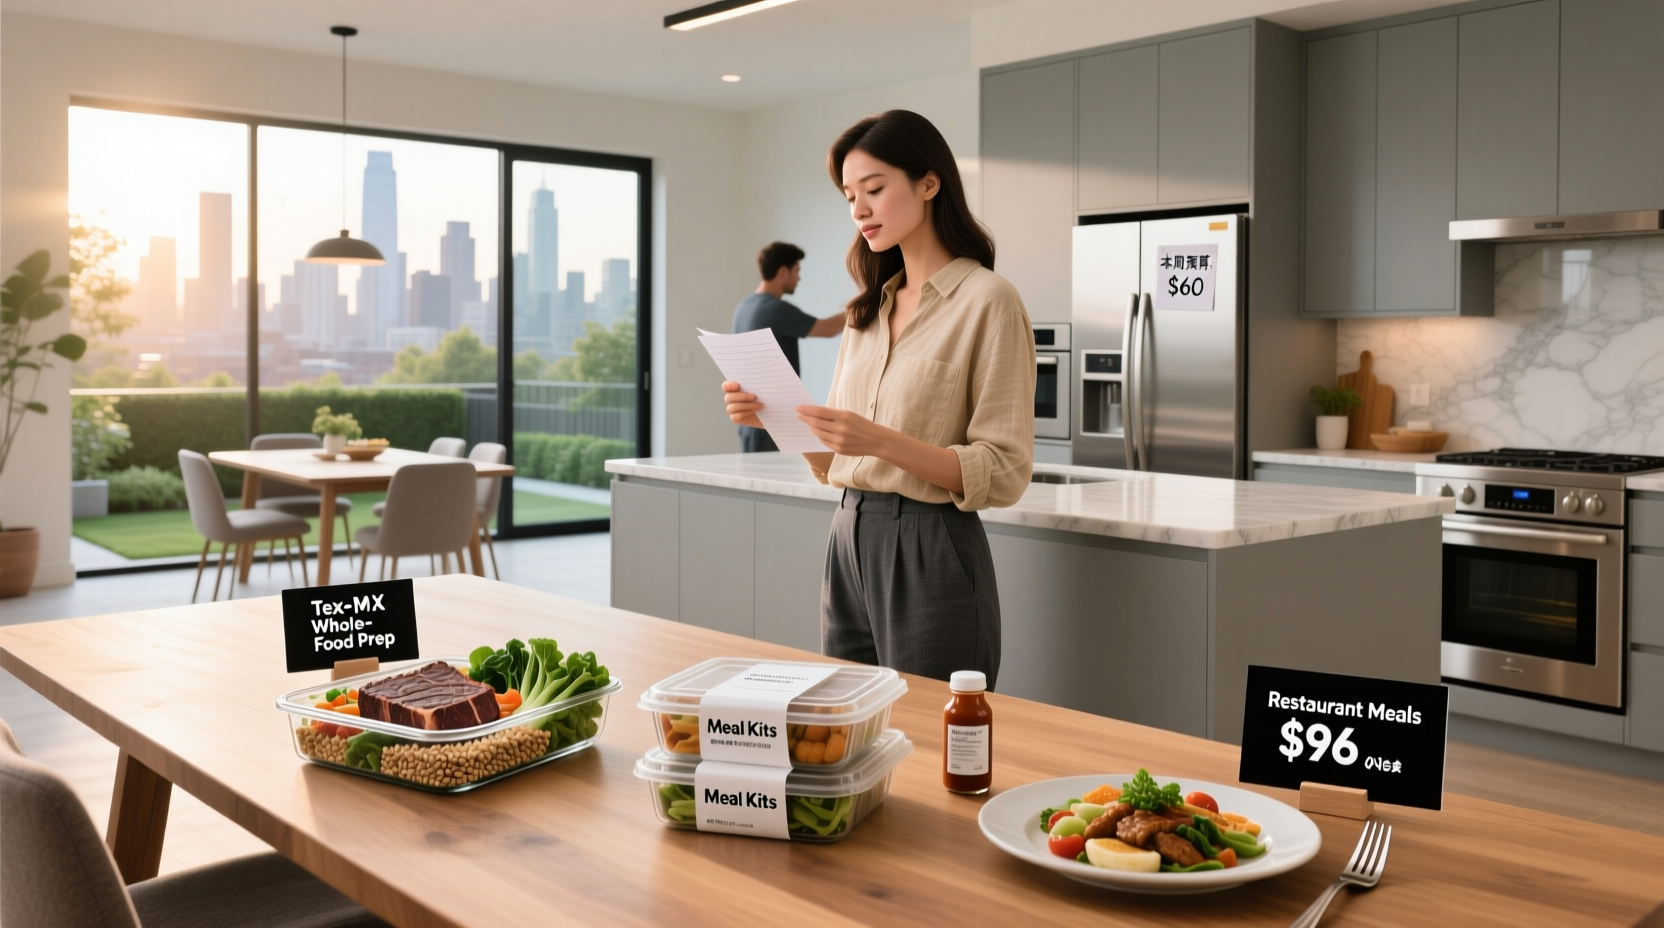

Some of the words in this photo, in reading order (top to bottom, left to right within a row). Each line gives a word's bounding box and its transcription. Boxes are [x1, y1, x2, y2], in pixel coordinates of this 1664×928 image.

[1168, 274, 1204, 297] $60
[311, 593, 386, 616] Tex-MX
[311, 616, 373, 634] Whole-
[314, 633, 354, 652] Food
[357, 632, 396, 649] Prep
[1268, 691, 1363, 718] Restaurant
[1368, 702, 1422, 725] Meals
[707, 718, 745, 735] Meal
[747, 720, 777, 738] Kits
[1278, 717, 1359, 766] $96
[704, 788, 743, 807] Meal
[746, 791, 778, 810] Kits
